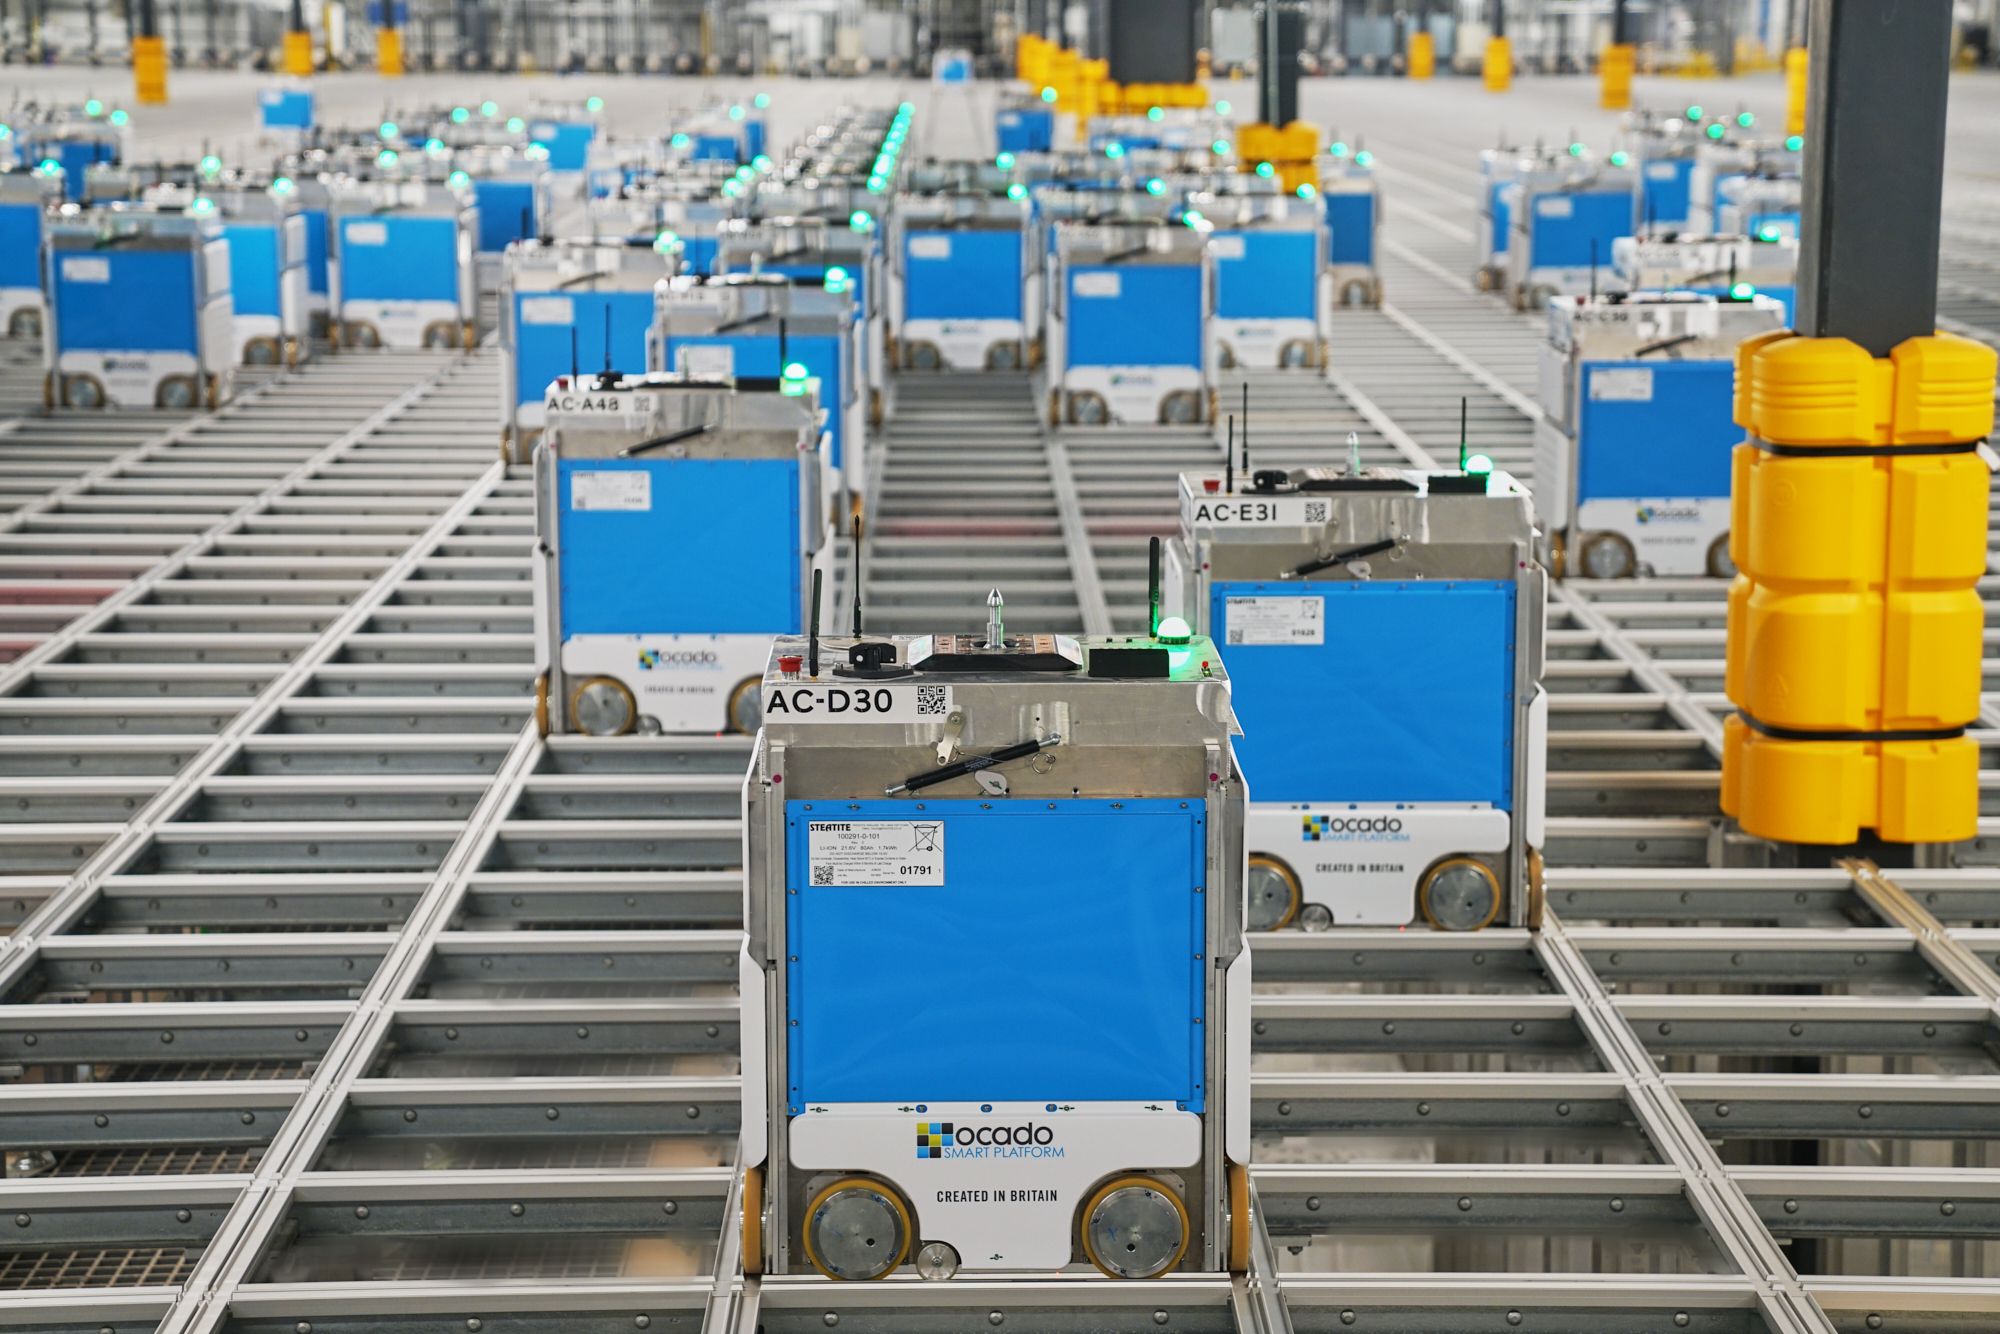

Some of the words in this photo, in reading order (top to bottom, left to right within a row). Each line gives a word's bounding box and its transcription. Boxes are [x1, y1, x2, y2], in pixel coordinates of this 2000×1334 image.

[547, 397, 619, 411] AC-A48
[661, 650, 717, 664] ocado
[766, 689, 893, 713] AC-D30
[810, 823, 851, 831] STEATITE
[1331, 816, 1402, 832] ocado
[1322, 833, 1354, 841] SMART
[1358, 833, 1410, 841] PLATFORM
[900, 866, 932, 875] 01791
[1315, 864, 1353, 872] CREATED
[1357, 864, 1366, 872] IN
[1369, 864, 1404, 872] BRITAIN
[956, 1122, 1053, 1145] ocado
[944, 1147, 986, 1158] SMART
[994, 1146, 1065, 1158] PLATFORM
[936, 1191, 988, 1202] CREATED
[994, 1190, 1005, 1202] IN
[1010, 1190, 1057, 1202] BRITAIN
